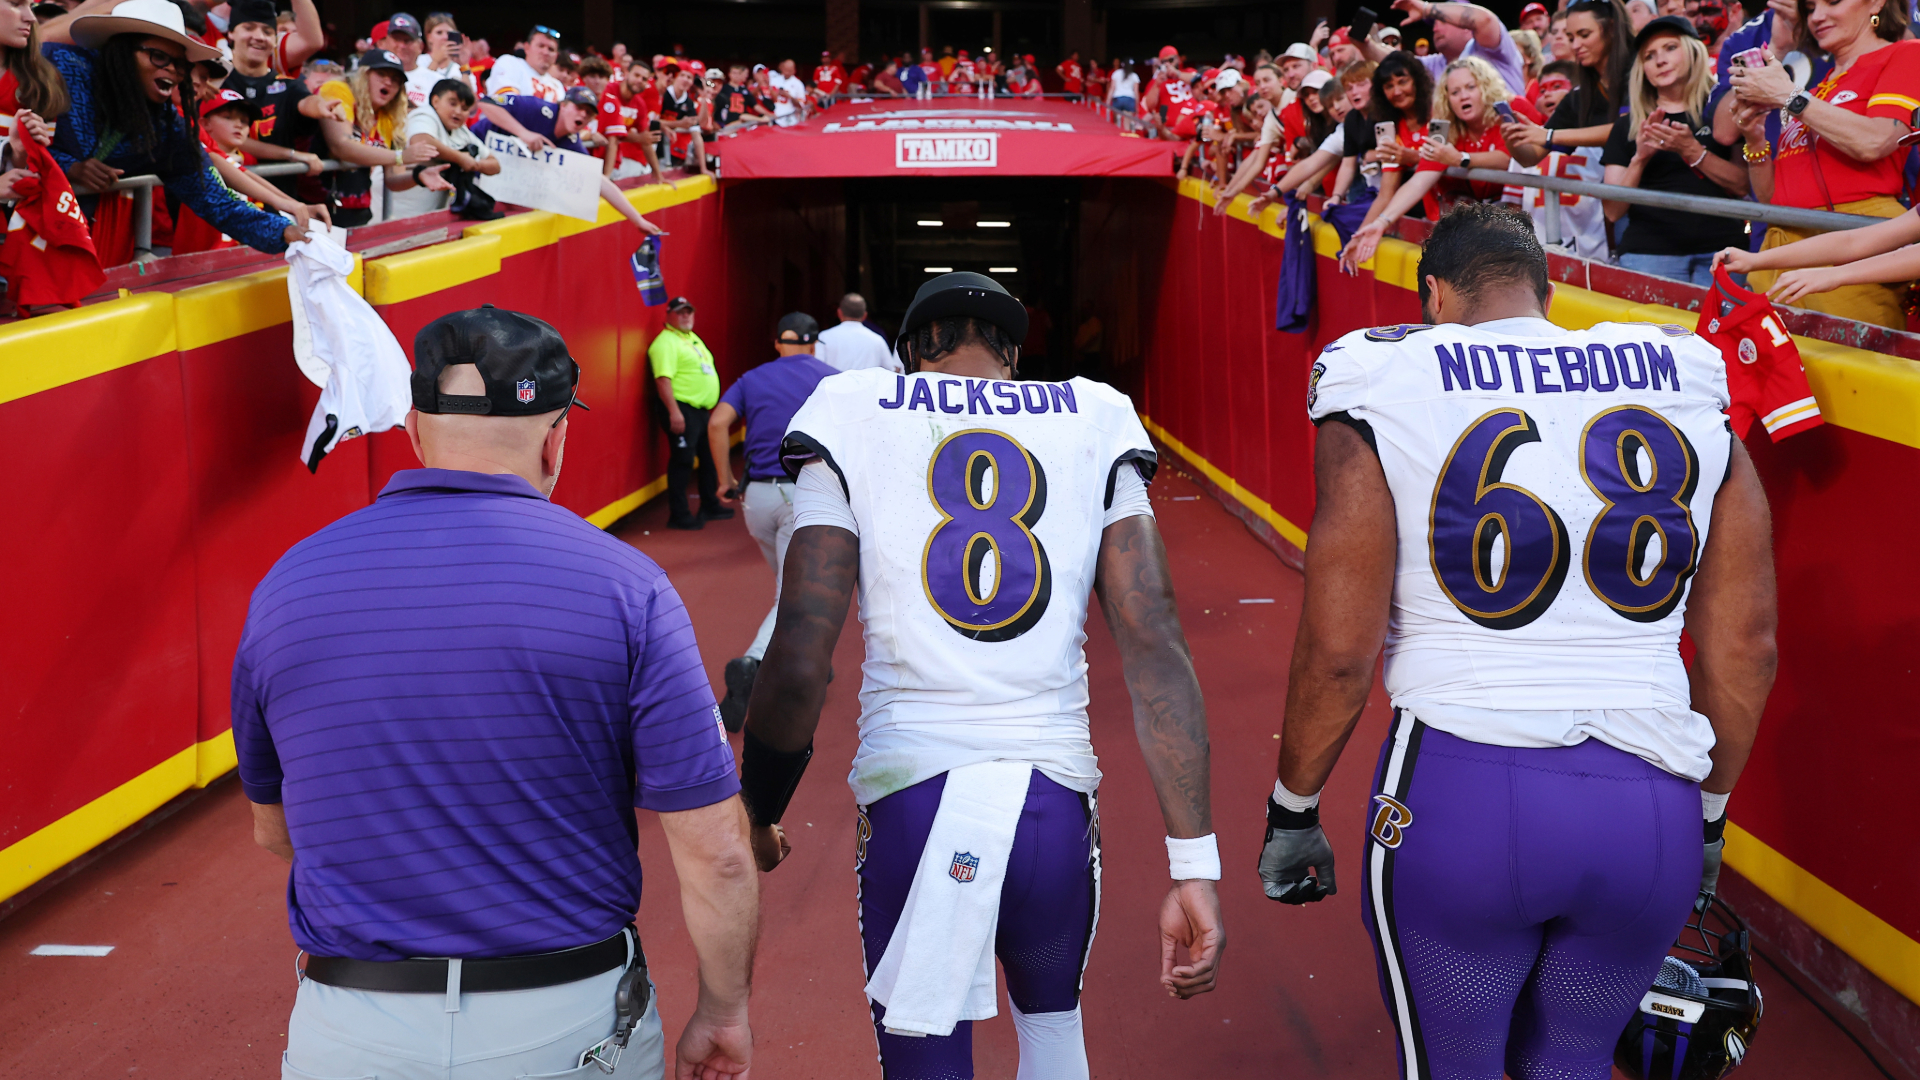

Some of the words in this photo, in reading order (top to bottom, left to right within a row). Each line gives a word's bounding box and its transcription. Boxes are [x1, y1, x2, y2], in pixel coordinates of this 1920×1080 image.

[904, 139, 989, 161] TAMKO
[1434, 342, 1681, 394] NOTEBOOM
[520, 390, 533, 400] NFL
[878, 375, 1079, 415] JACKSON
[1427, 404, 1699, 630] 68
[921, 428, 1052, 642] 8
[952, 863, 973, 880] NFL
[1651, 1001, 1685, 1017] RAVENS
